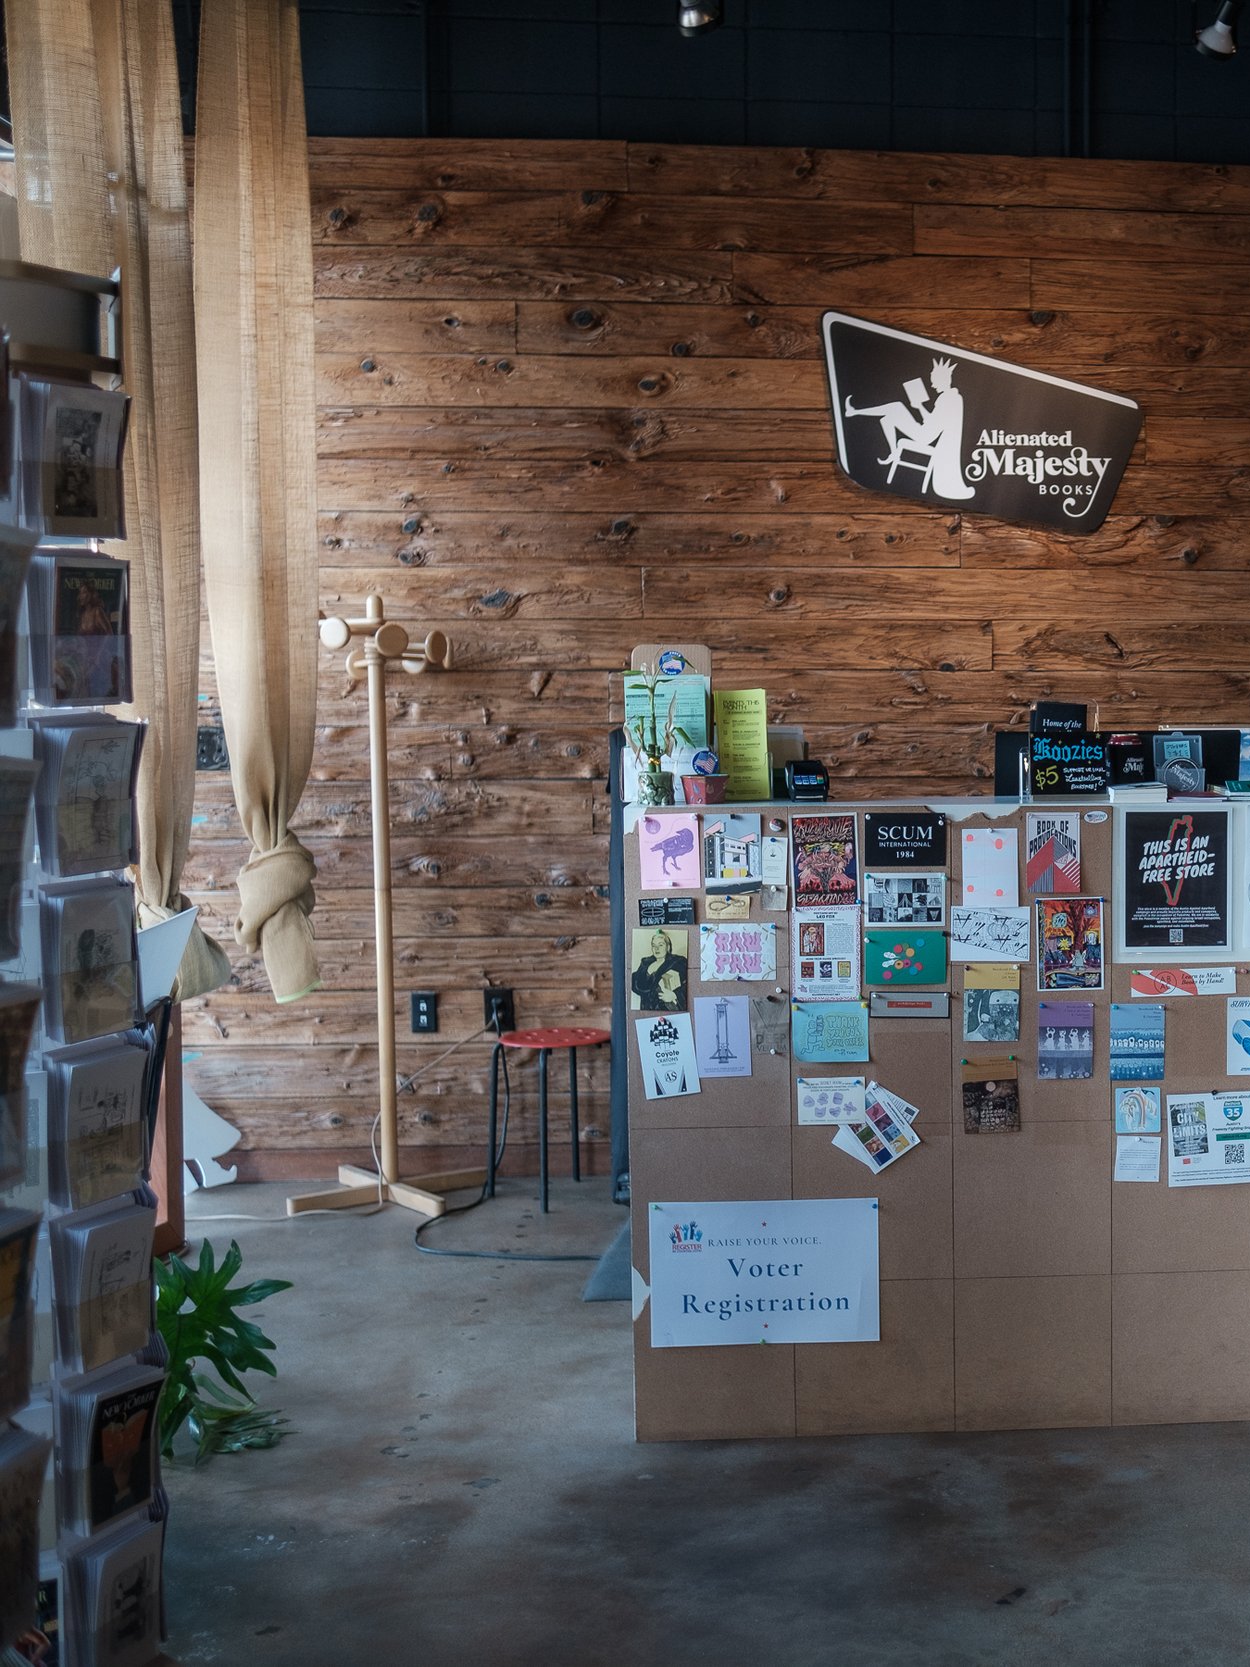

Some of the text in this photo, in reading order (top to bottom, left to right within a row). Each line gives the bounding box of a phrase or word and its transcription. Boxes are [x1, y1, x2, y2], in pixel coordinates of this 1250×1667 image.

[976, 429, 1073, 447] Alienated
[965, 447, 1113, 518] Majesty
[1039, 484, 1094, 496] BOOKS
[1043, 718, 1083, 730] Home of the
[1033, 737, 1103, 763] Koozies
[1035, 764, 1060, 790] $5
[878, 825, 934, 842] SCUM
[1037, 820, 1069, 836] BOOK OF
[879, 841, 932, 849] INTERNATIONAL
[1143, 835, 1210, 856] THIS IS AN
[896, 850, 915, 860] 1984
[1138, 850, 1216, 871] APARTHEID-
[1142, 862, 1216, 884] FREE STORE
[714, 931, 763, 953] RAW
[714, 953, 763, 974] PAW
[655, 1049, 680, 1060] Coyote
[1226, 1108, 1240, 1117] 35
[672, 1243, 703, 1251] REGISTER
[707, 1237, 742, 1248] RAISE
[745, 1237, 778, 1247] YOUR
[727, 1257, 804, 1278] Voter
[682, 1292, 850, 1321] Registration
